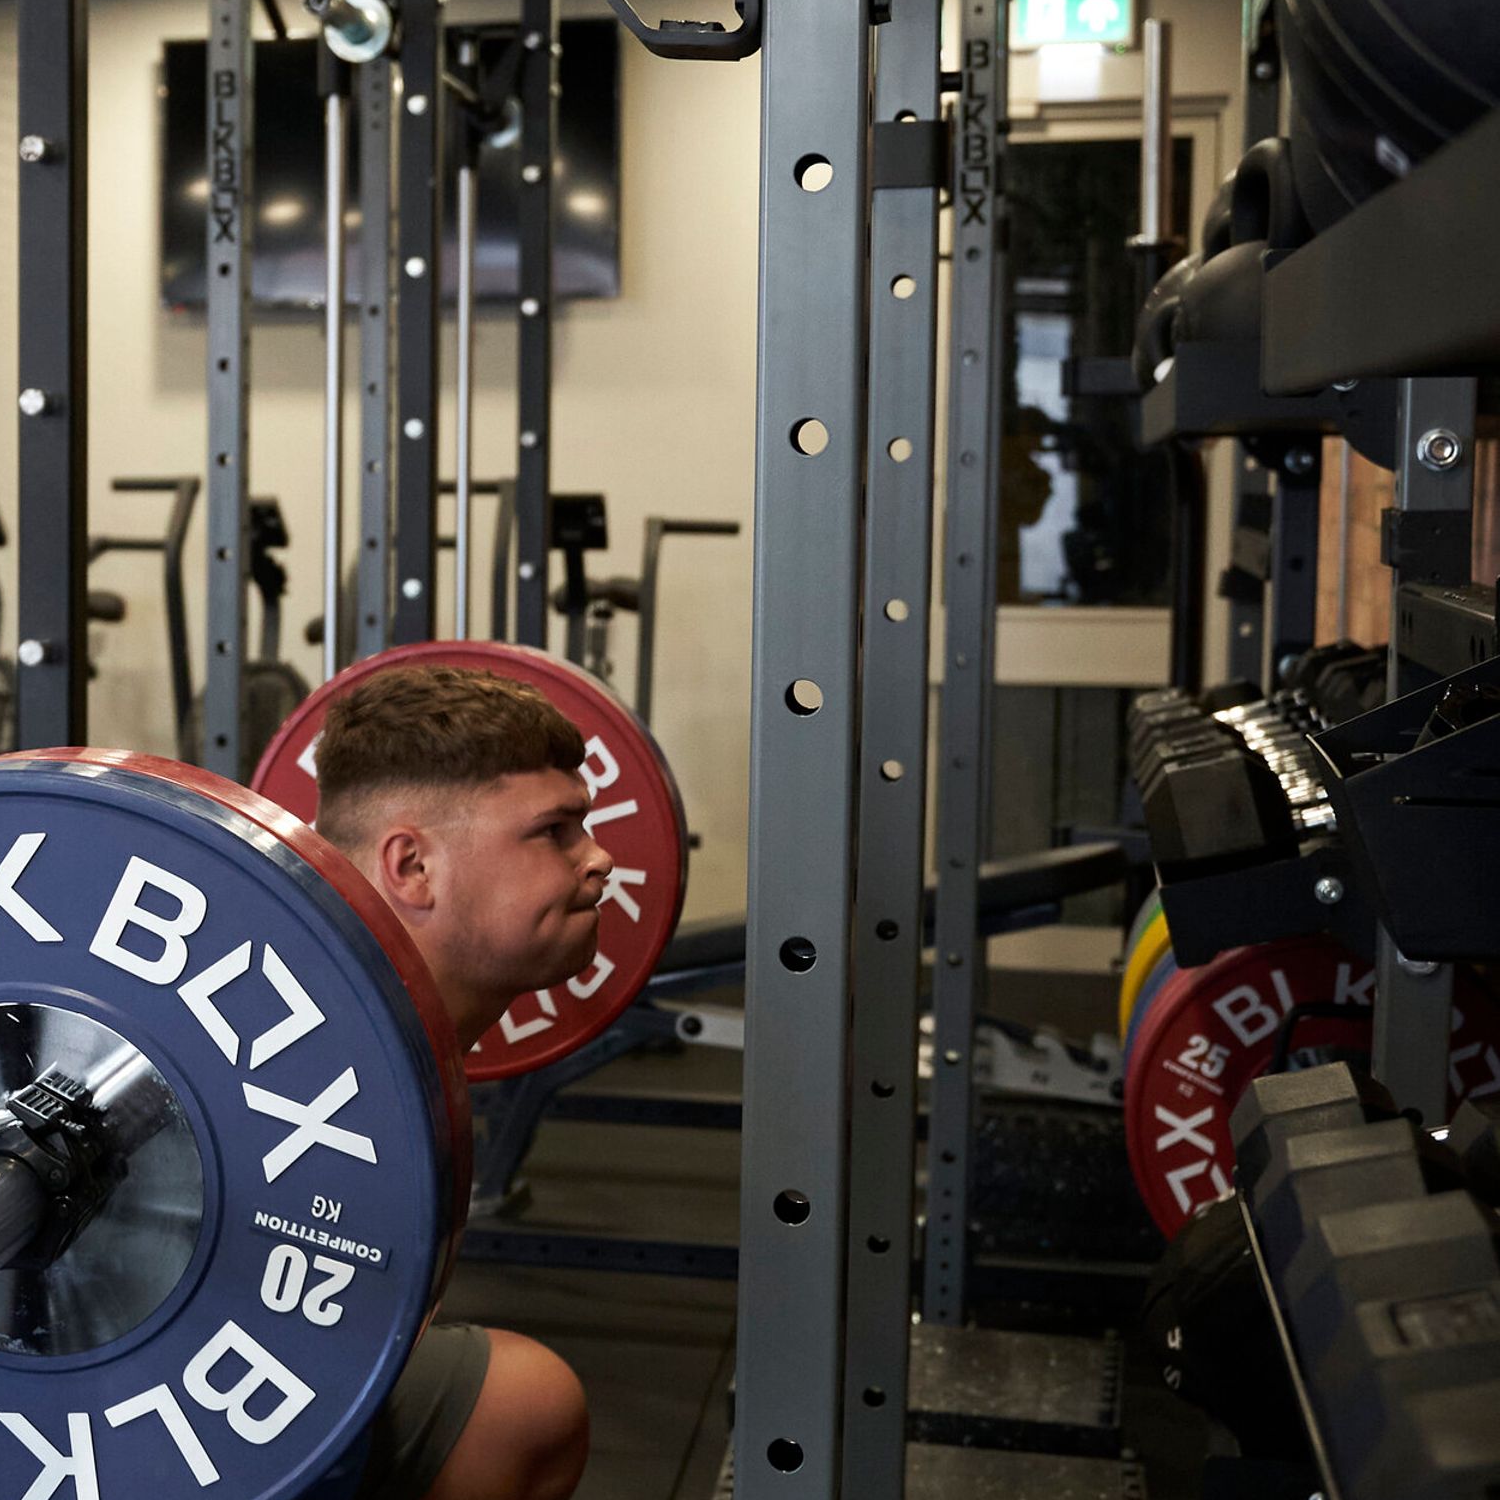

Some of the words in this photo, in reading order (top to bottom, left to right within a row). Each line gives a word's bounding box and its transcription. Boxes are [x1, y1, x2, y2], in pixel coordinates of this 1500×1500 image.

[1177, 1034, 1231, 1079] 25
[1154, 1104, 1236, 1216] OX
[311, 1195, 342, 1223] KG
[254, 1211, 382, 1263] COMPETITION
[260, 1244, 356, 1326] 20
